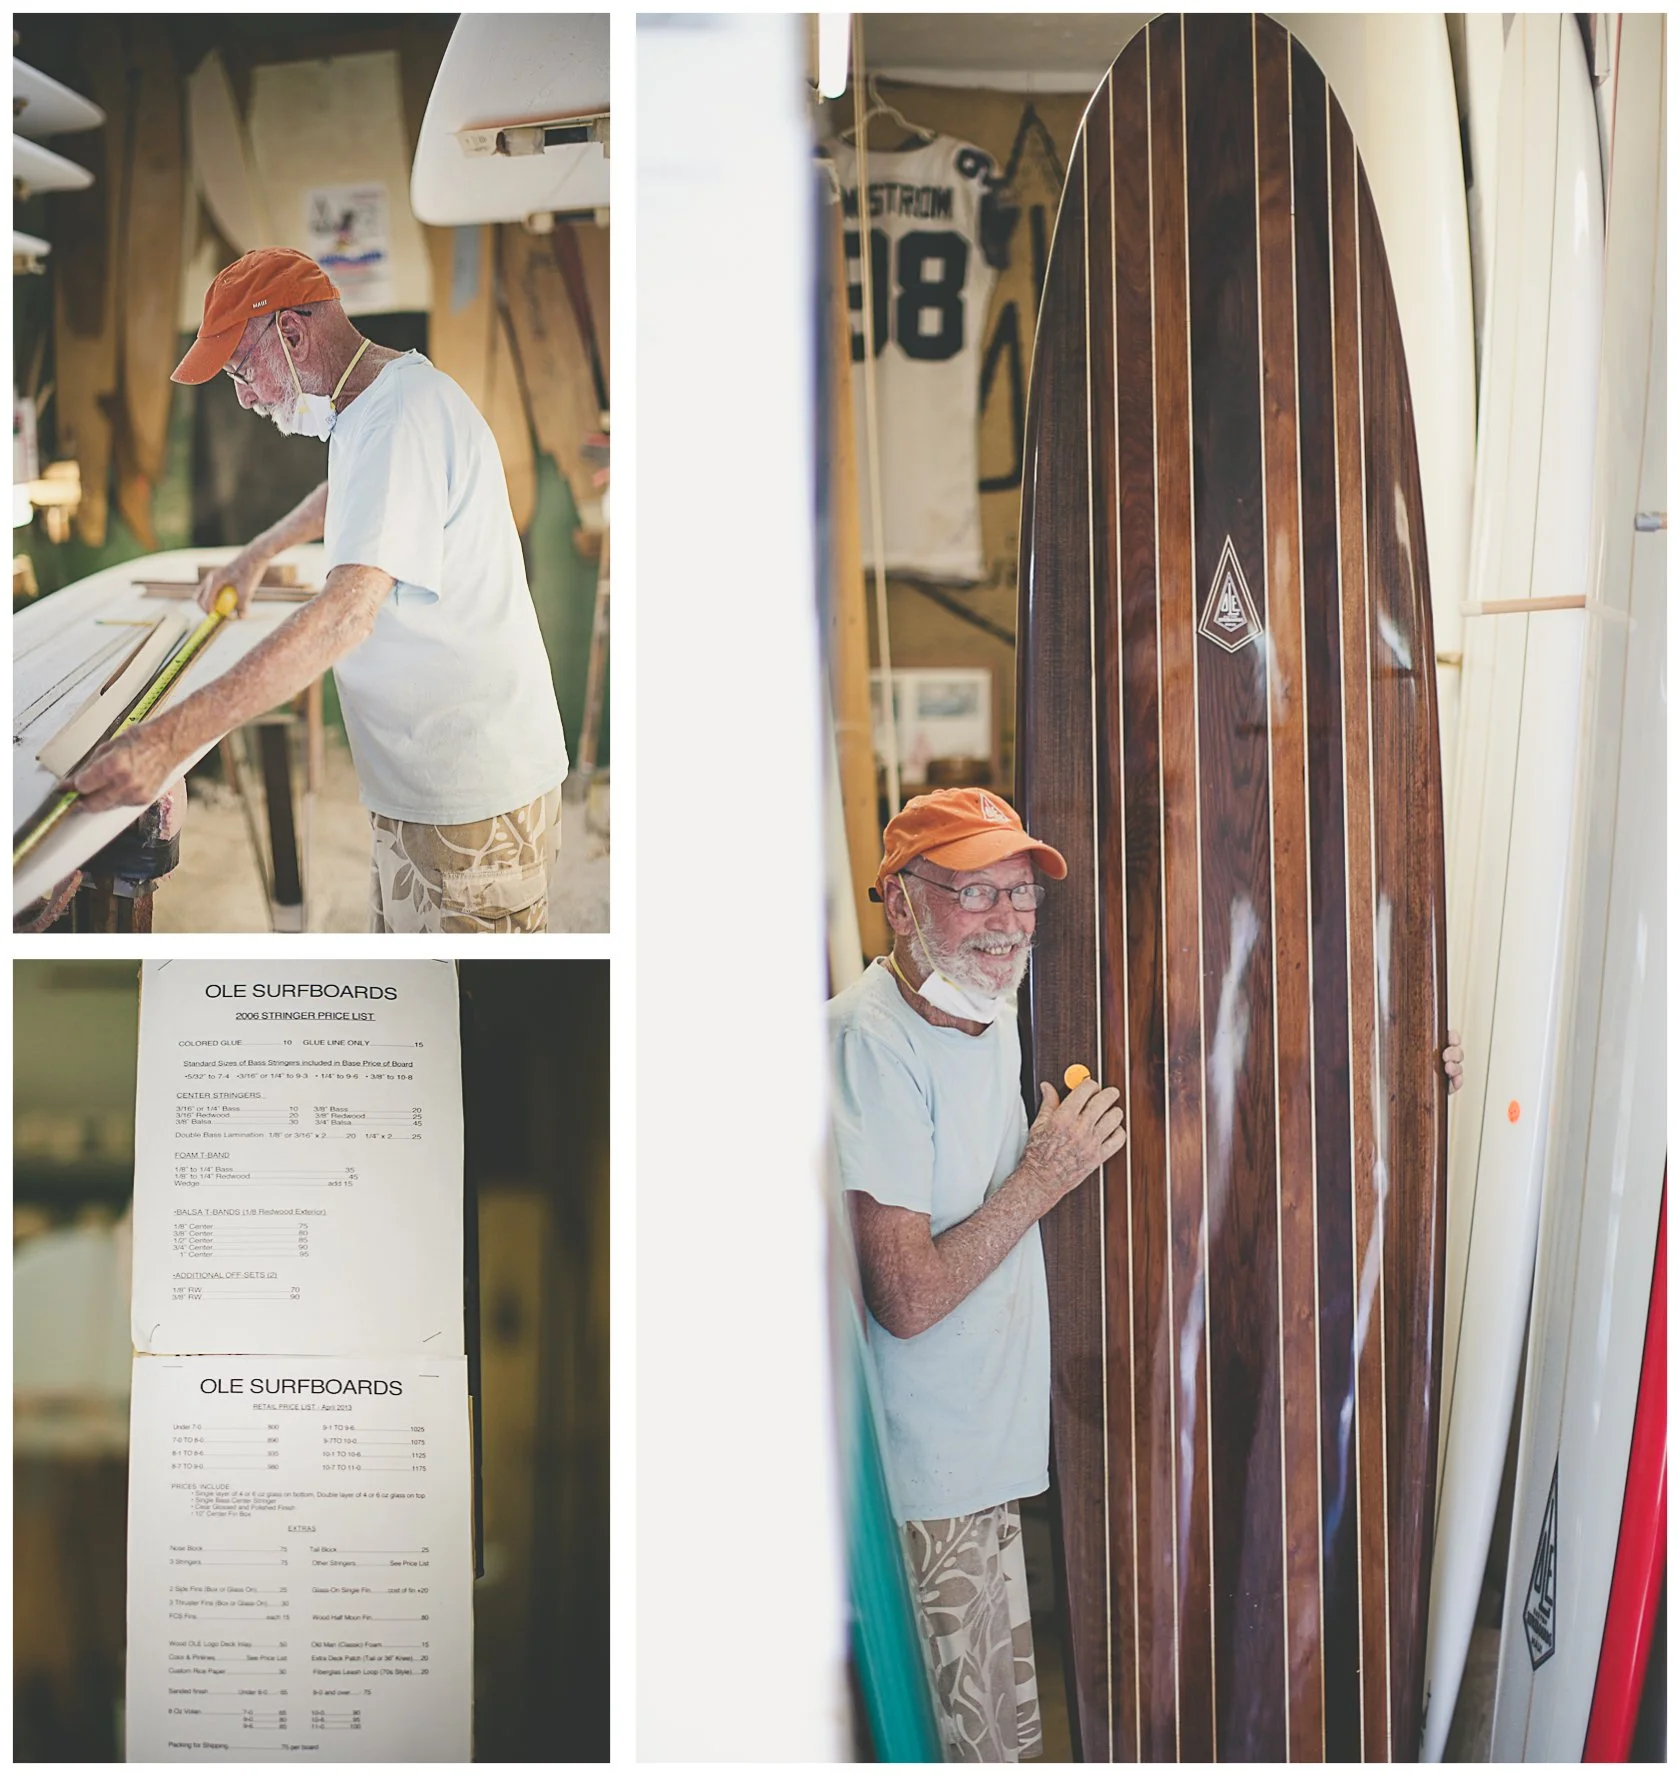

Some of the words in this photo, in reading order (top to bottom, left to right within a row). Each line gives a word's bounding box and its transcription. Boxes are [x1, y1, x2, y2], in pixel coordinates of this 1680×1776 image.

[252, 300, 268, 308] MAUI
[205, 984, 246, 998] OLE
[252, 984, 398, 1000] SURFBOARDS
[236, 1012, 259, 1020] 2006
[261, 1012, 315, 1020] STRINGER
[318, 1012, 350, 1020] PRICE
[352, 1013, 375, 1021] LIST
[200, 1379, 243, 1394] OLE
[250, 1379, 403, 1396] SURFBOARDS
